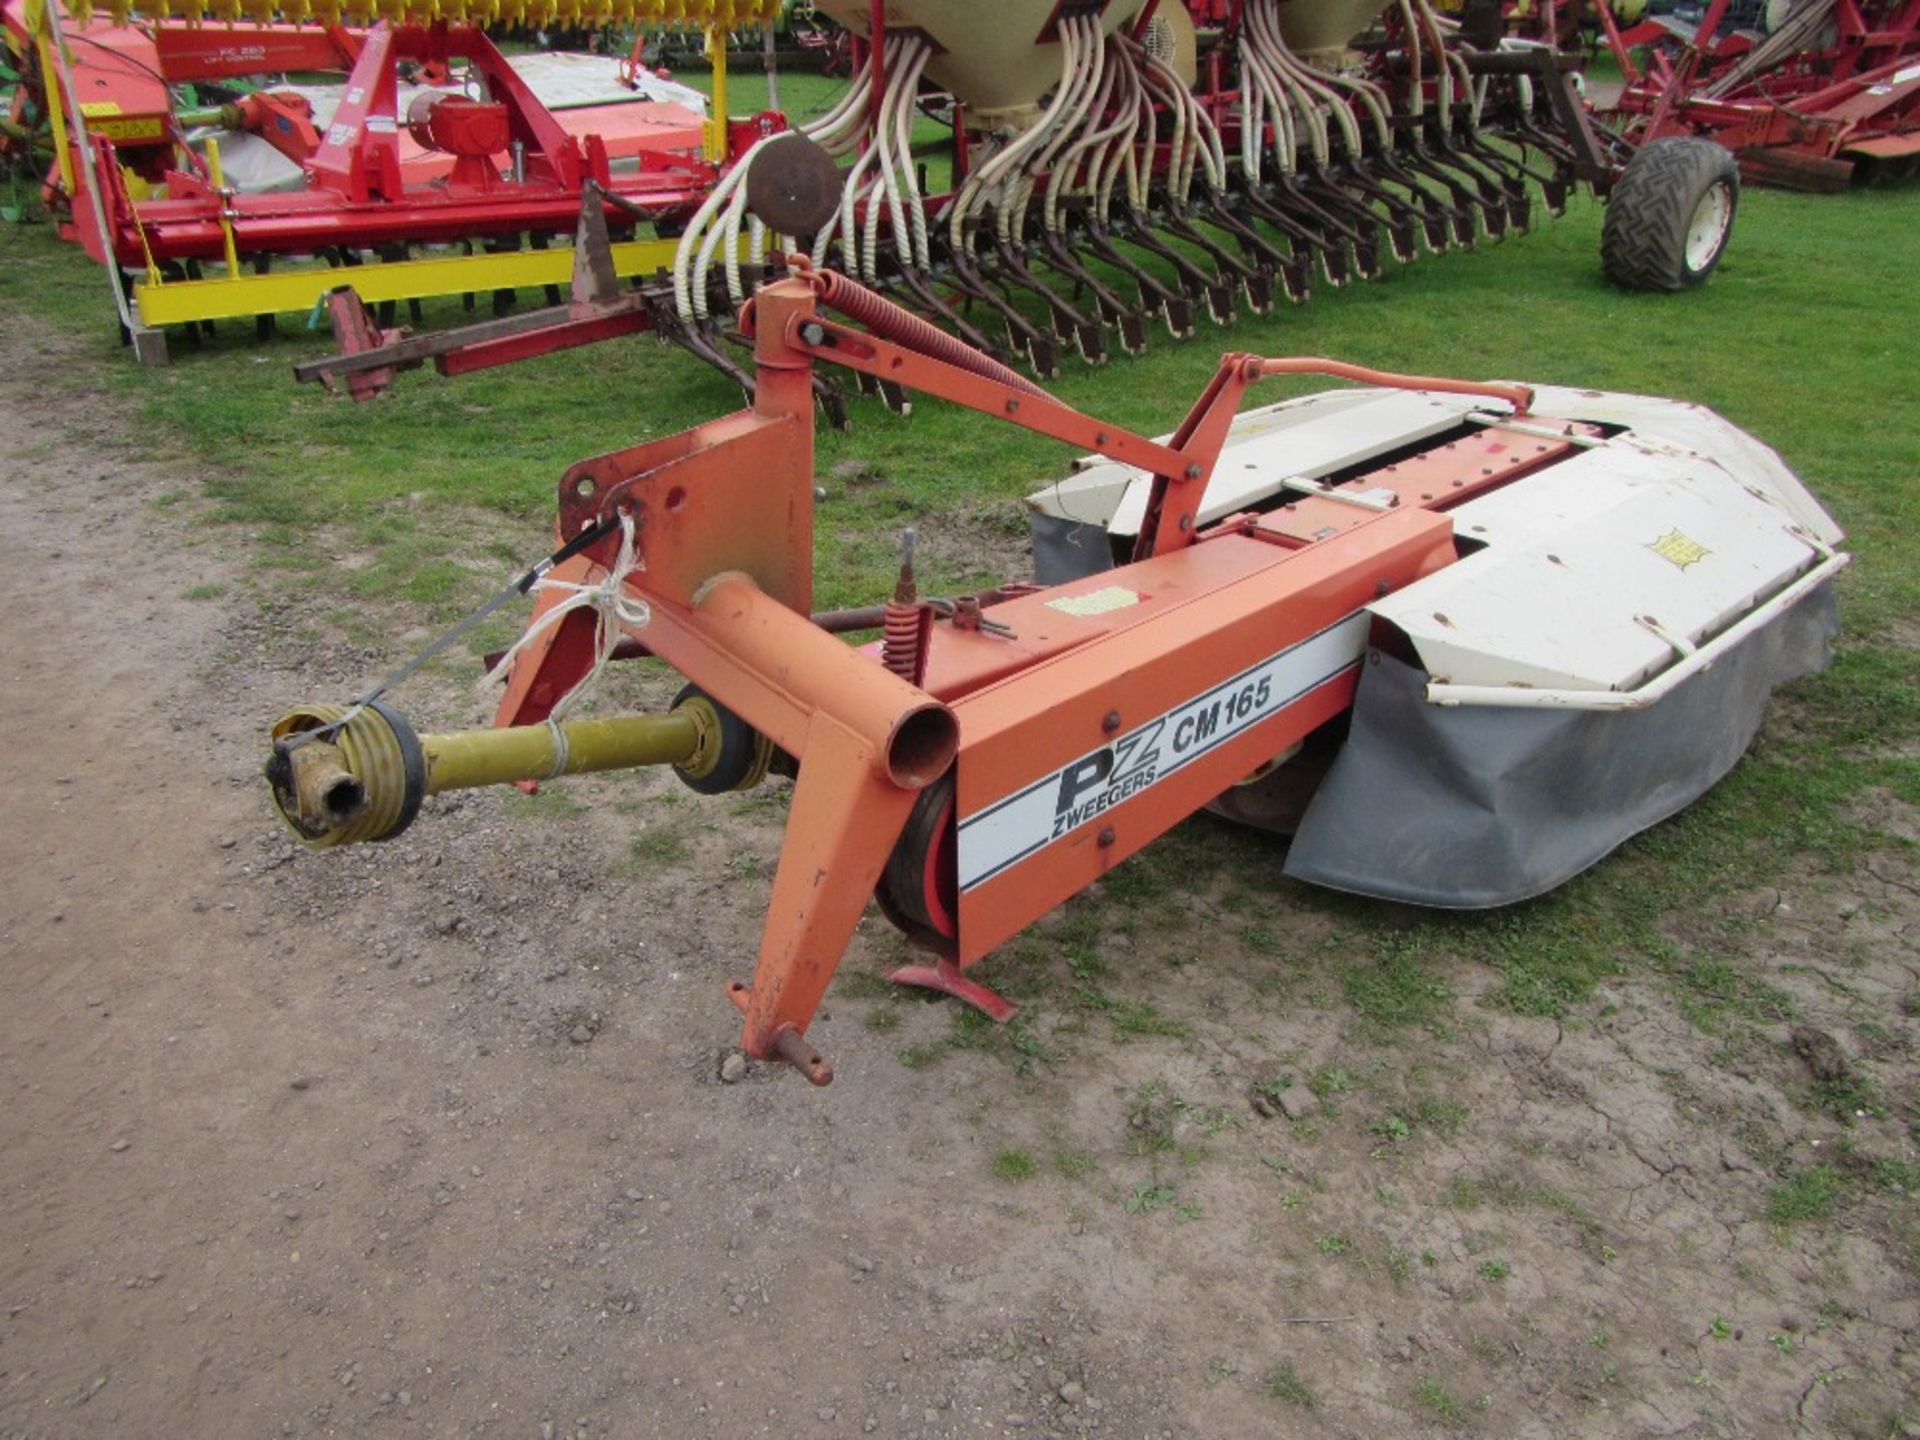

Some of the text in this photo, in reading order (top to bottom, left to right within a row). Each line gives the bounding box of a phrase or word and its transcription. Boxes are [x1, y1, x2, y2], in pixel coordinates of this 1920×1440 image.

[1173, 674, 1272, 753] CM 165
[1051, 765, 1157, 838] ZWEEGERS
